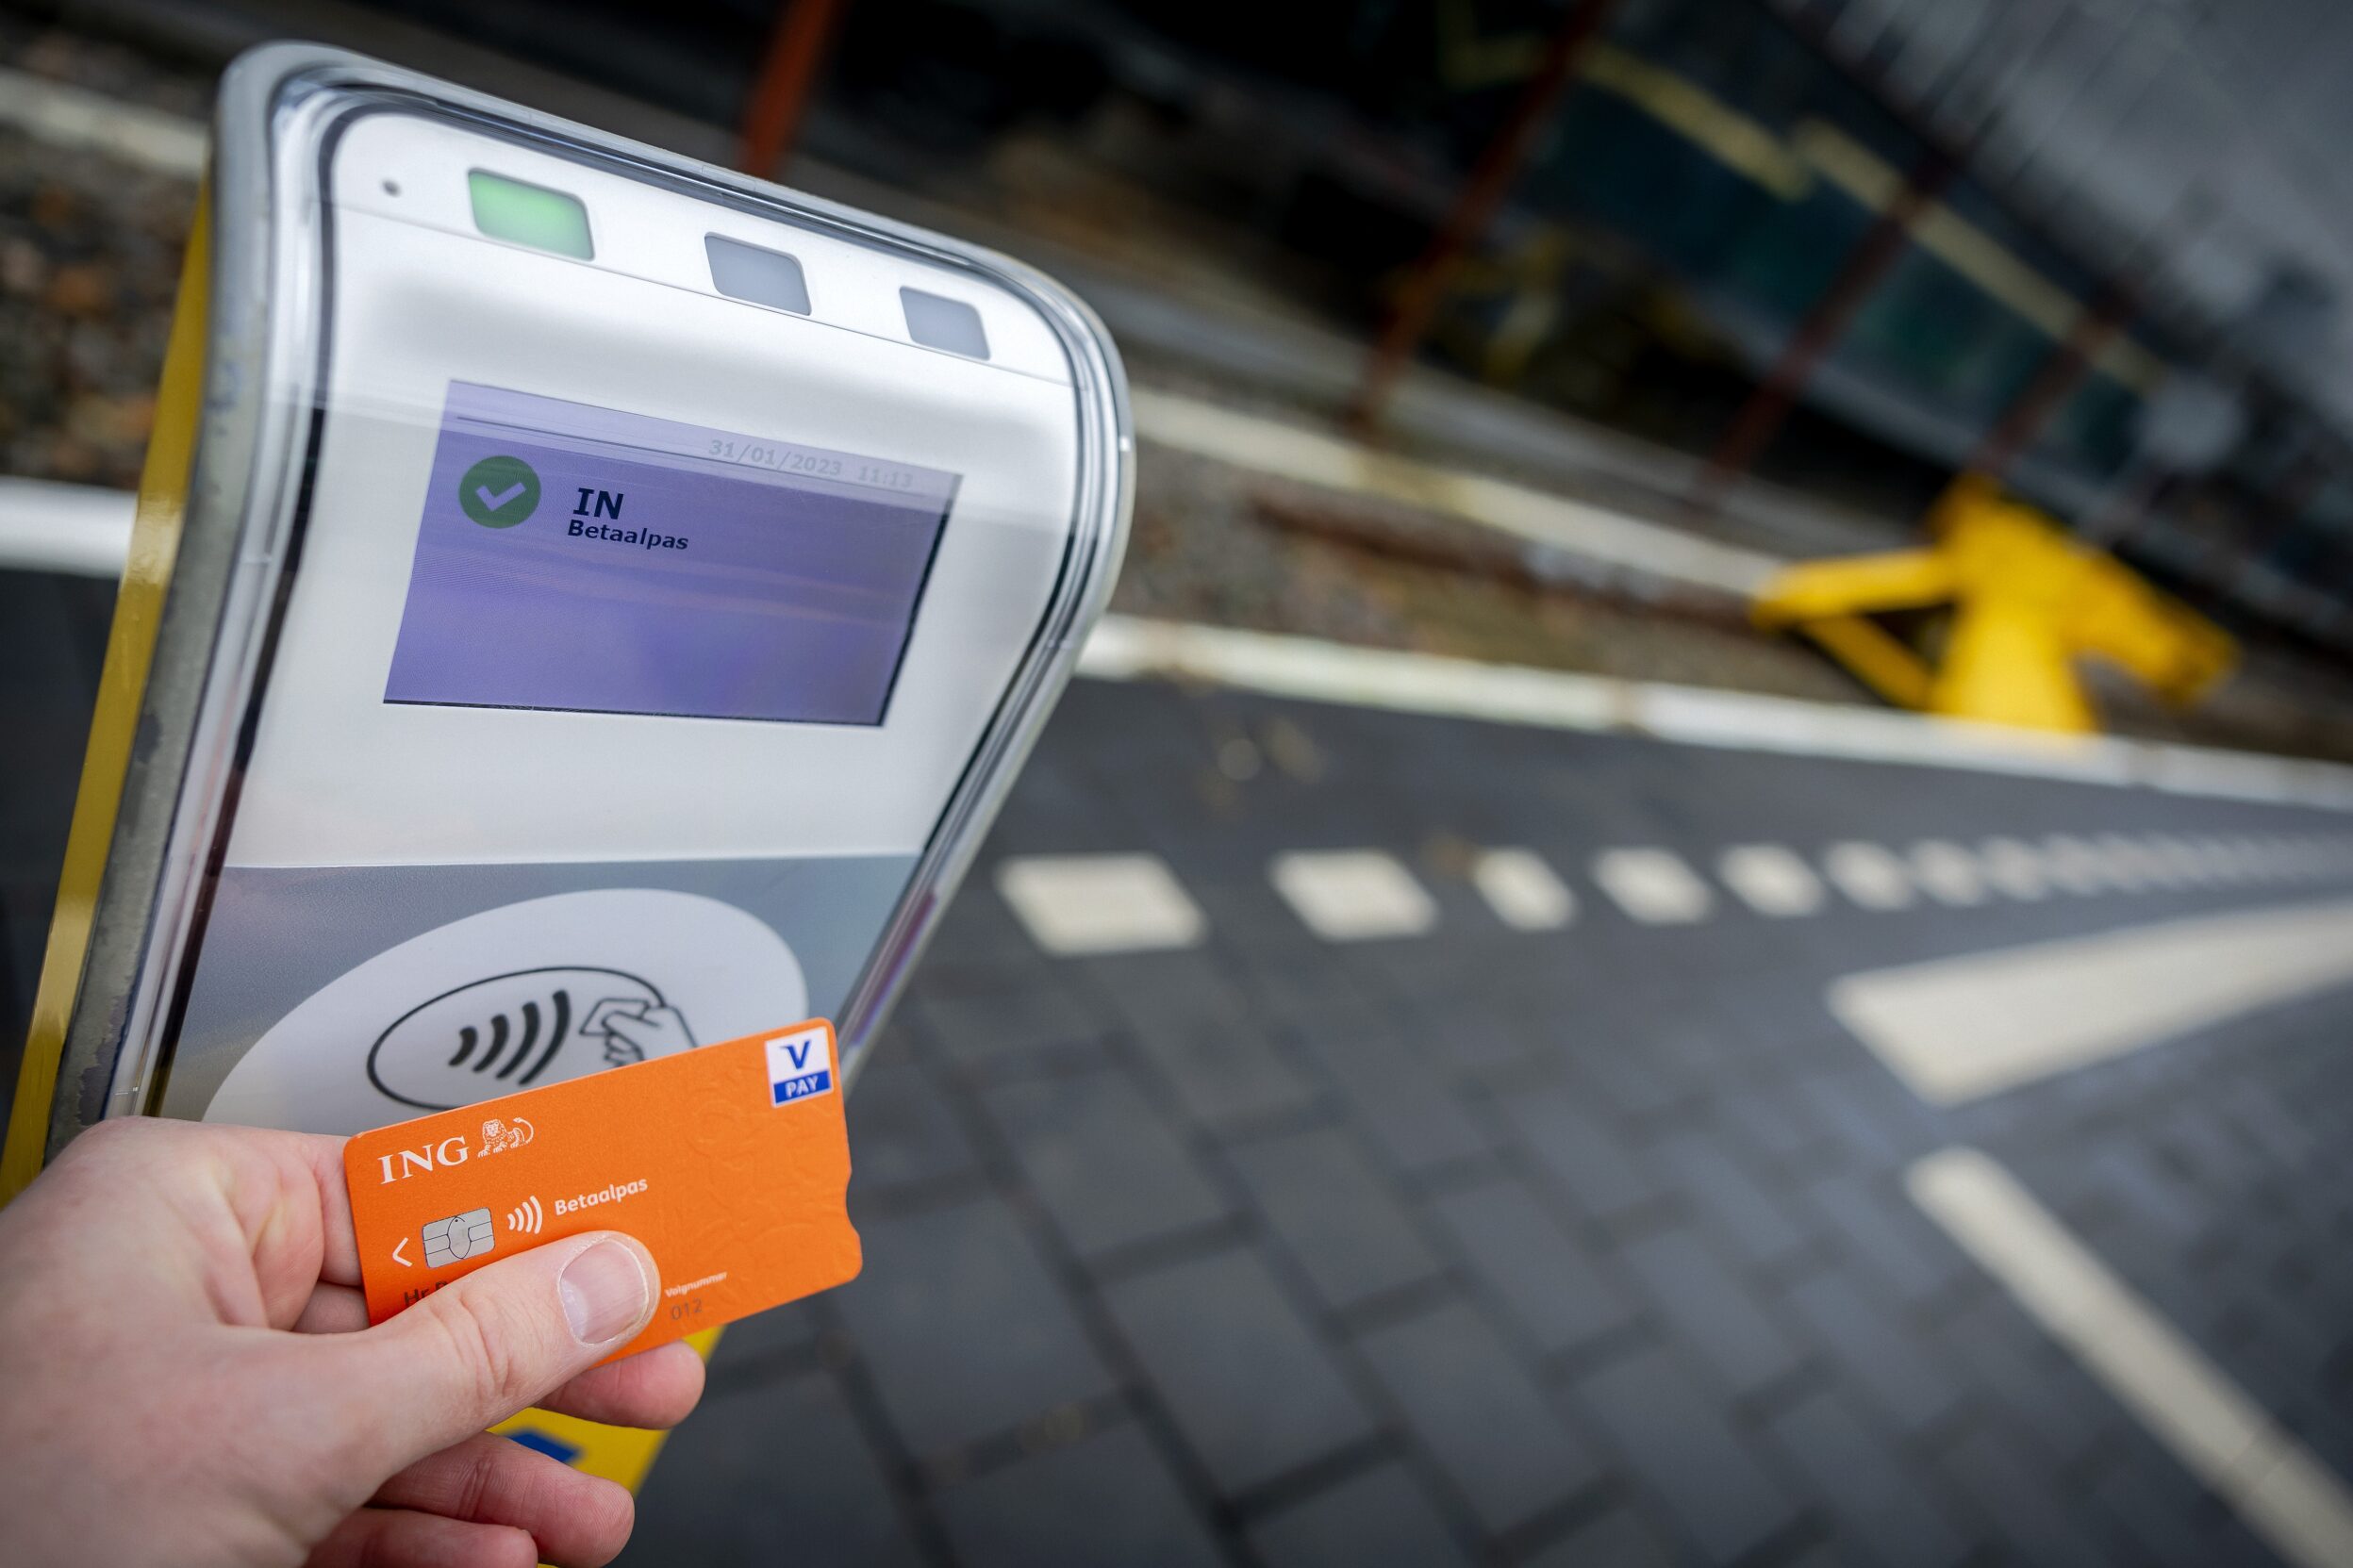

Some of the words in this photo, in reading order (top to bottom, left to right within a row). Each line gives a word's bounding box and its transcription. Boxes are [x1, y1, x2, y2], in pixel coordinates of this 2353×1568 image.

[708, 439, 842, 477] 31/01/2023
[857, 466, 914, 488] 11:13
[572, 487, 624, 520] IN
[567, 519, 689, 551] Betaalpas
[780, 1040, 810, 1070] V
[785, 1075, 819, 1098] PAY
[378, 1135, 470, 1184] ING
[555, 1179, 648, 1215] Betaalpas
[671, 1297, 703, 1321] 012
